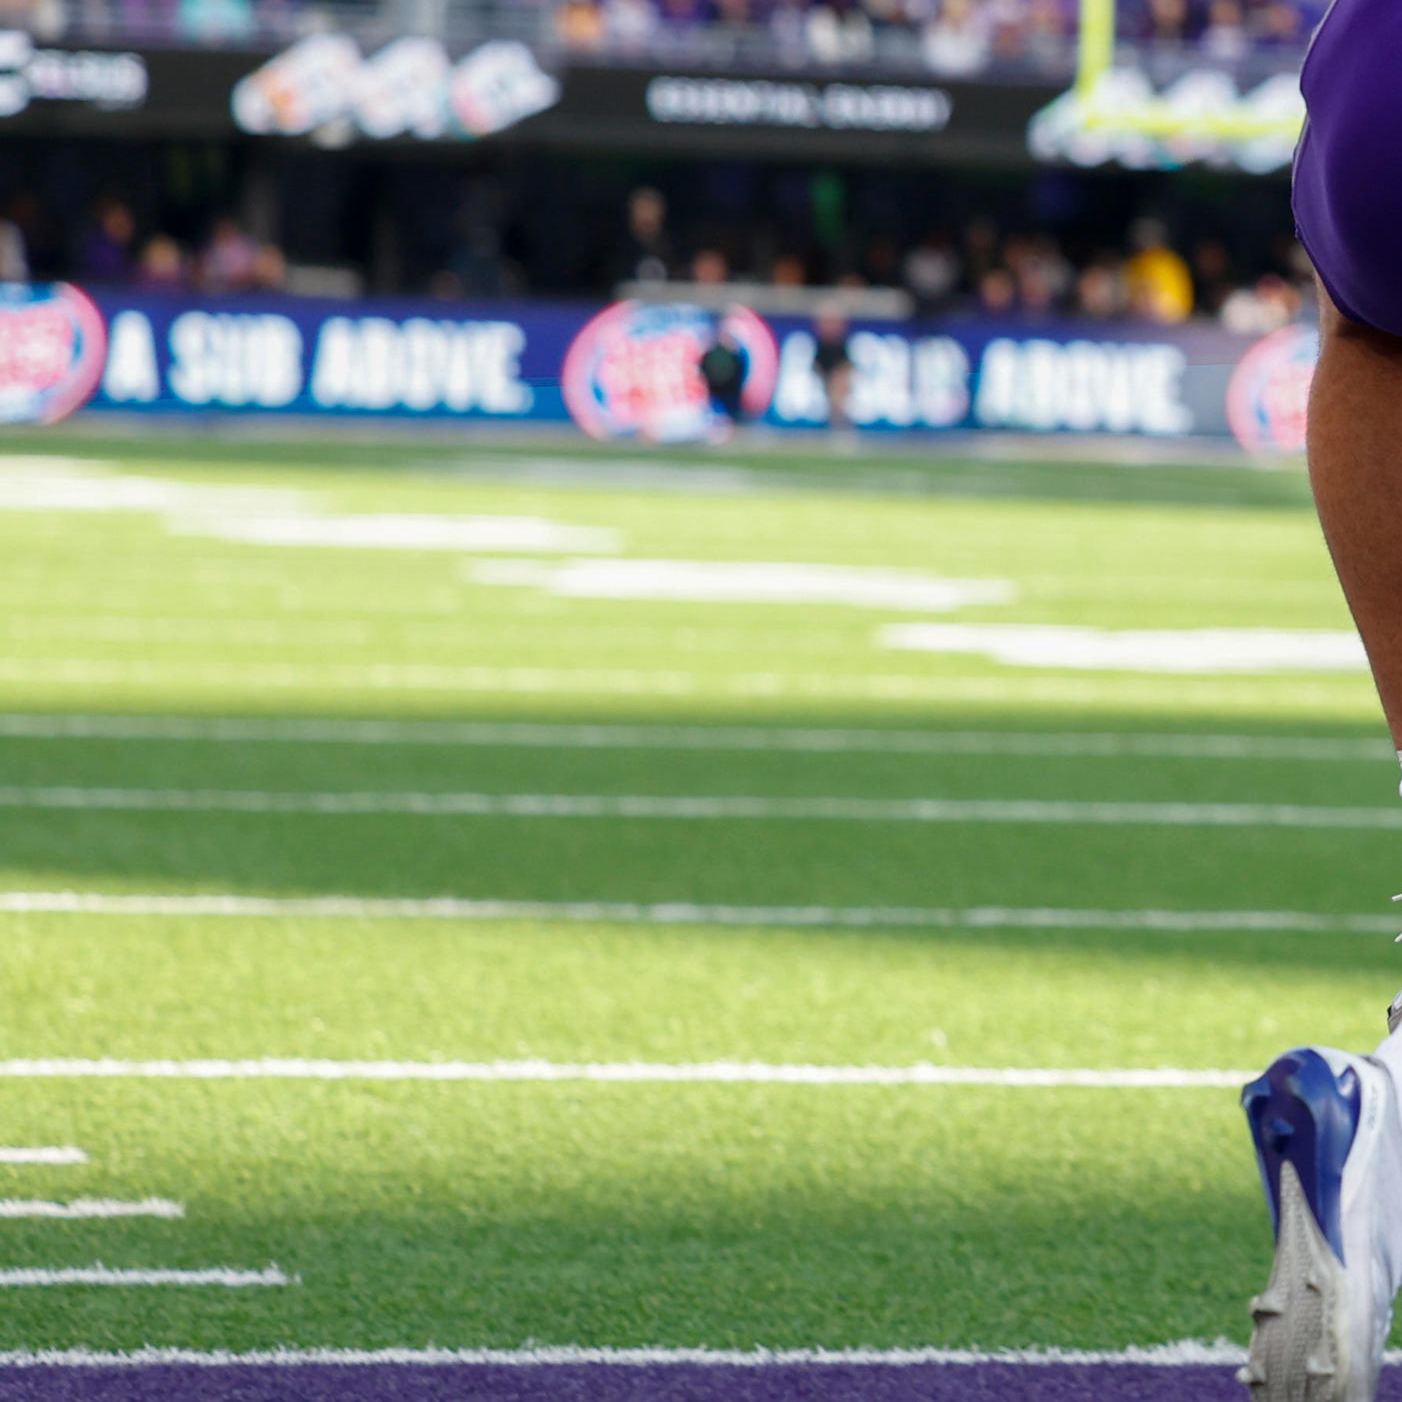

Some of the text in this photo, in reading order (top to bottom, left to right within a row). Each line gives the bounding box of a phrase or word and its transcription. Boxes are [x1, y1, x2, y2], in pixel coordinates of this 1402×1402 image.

[103, 311, 160, 402] A
[168, 311, 302, 406] SUB
[310, 316, 534, 414] ABOVE
[975, 337, 1193, 436] ABOVE
